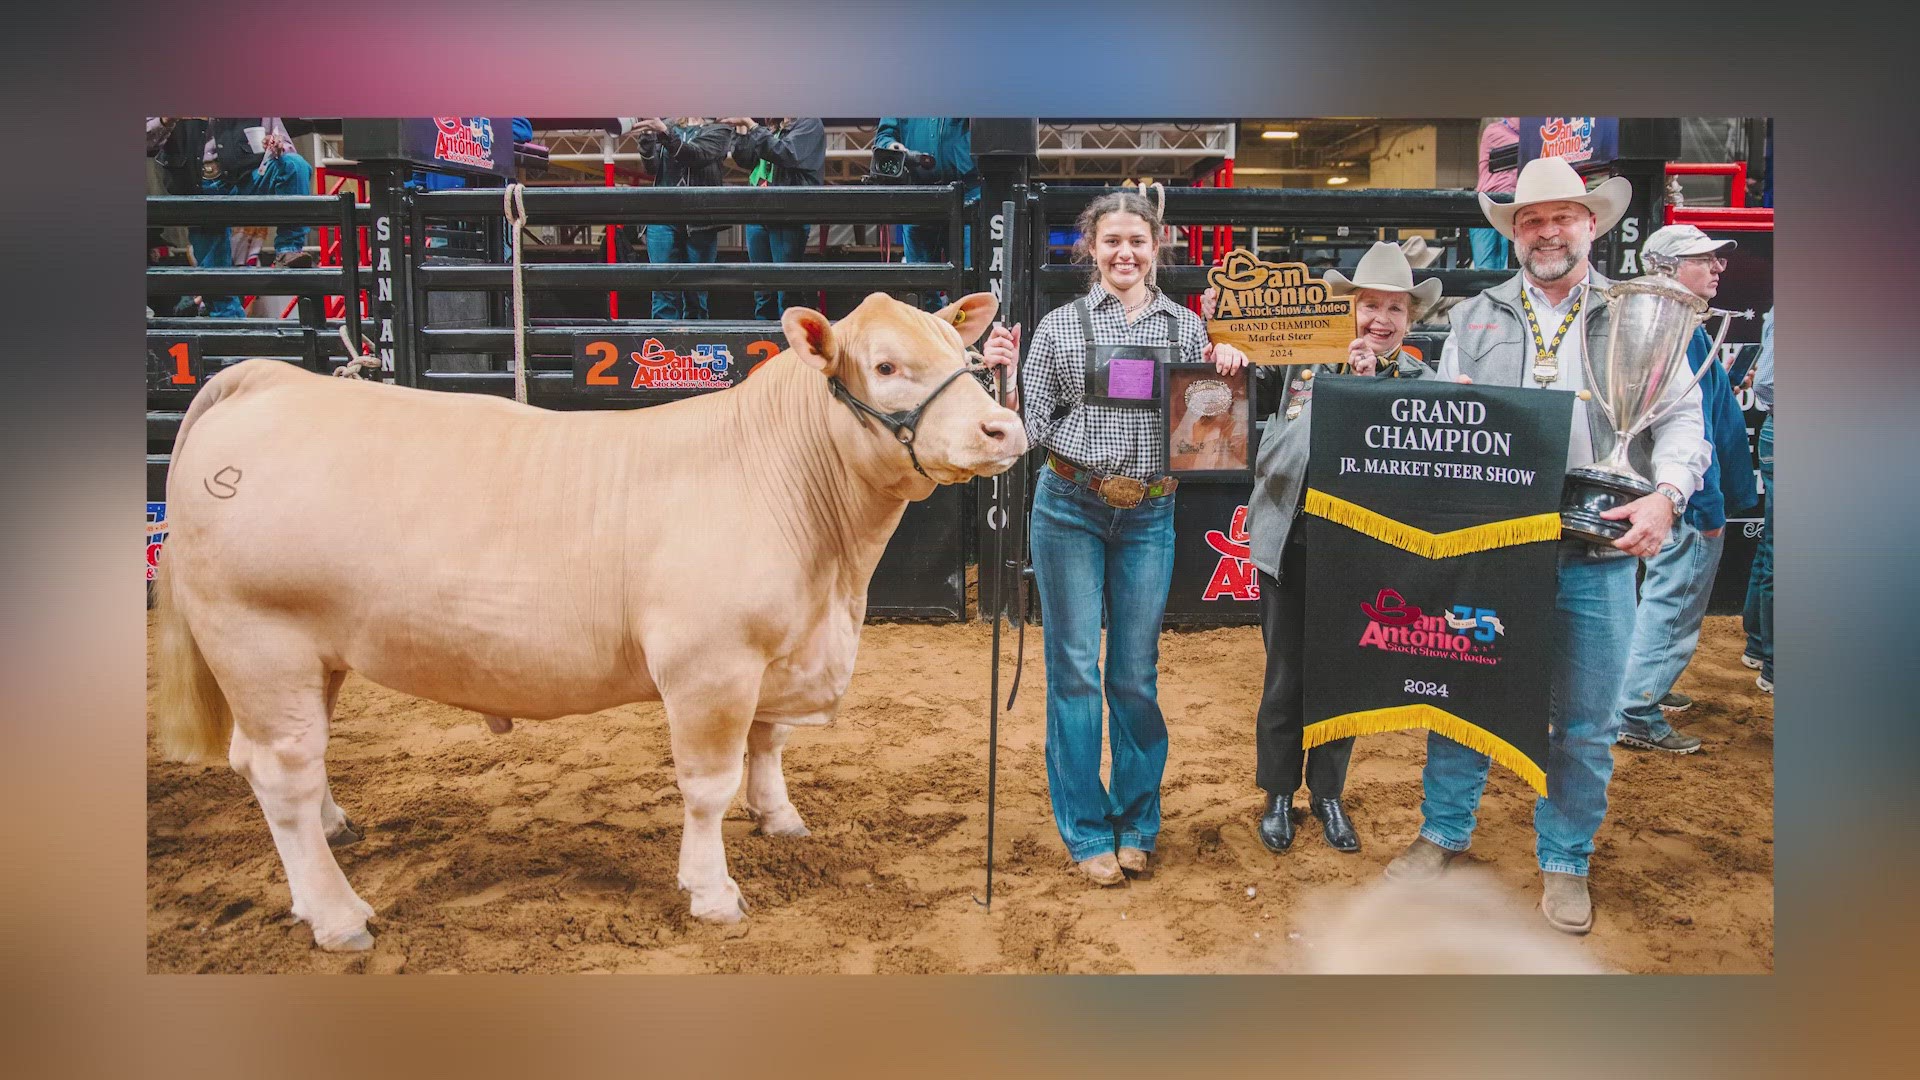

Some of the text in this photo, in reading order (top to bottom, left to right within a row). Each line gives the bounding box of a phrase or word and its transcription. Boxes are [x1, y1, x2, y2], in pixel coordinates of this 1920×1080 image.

[435, 131, 482, 159] Antonio
[376, 216, 393, 301] SAN
[1215, 254, 1301, 290] San
[1217, 286, 1324, 319] Antonio
[1246, 307, 1272, 317] Stock
[1276, 305, 1302, 316] Show
[1315, 303, 1347, 313] Rodeo
[1230, 320, 1330, 332] GRAND CHAMPION
[1248, 333, 1314, 343] Market Steer
[168, 342, 197, 385] 1
[585, 341, 619, 386] 2
[631, 338, 728, 371] San 75
[1270, 349, 1293, 358] 2024
[631, 366, 712, 388] Antonio
[1391, 398, 1487, 426] GRAND
[1364, 425, 1512, 457] CHAMPION
[1339, 456, 1536, 487] JR. MARKET STEER SHOW
[1360, 588, 1497, 642] San 75
[1359, 620, 1471, 652] Antonio
[1387, 643, 1497, 665] Stock Show & Rodeo
[1404, 679, 1449, 697] 2024
